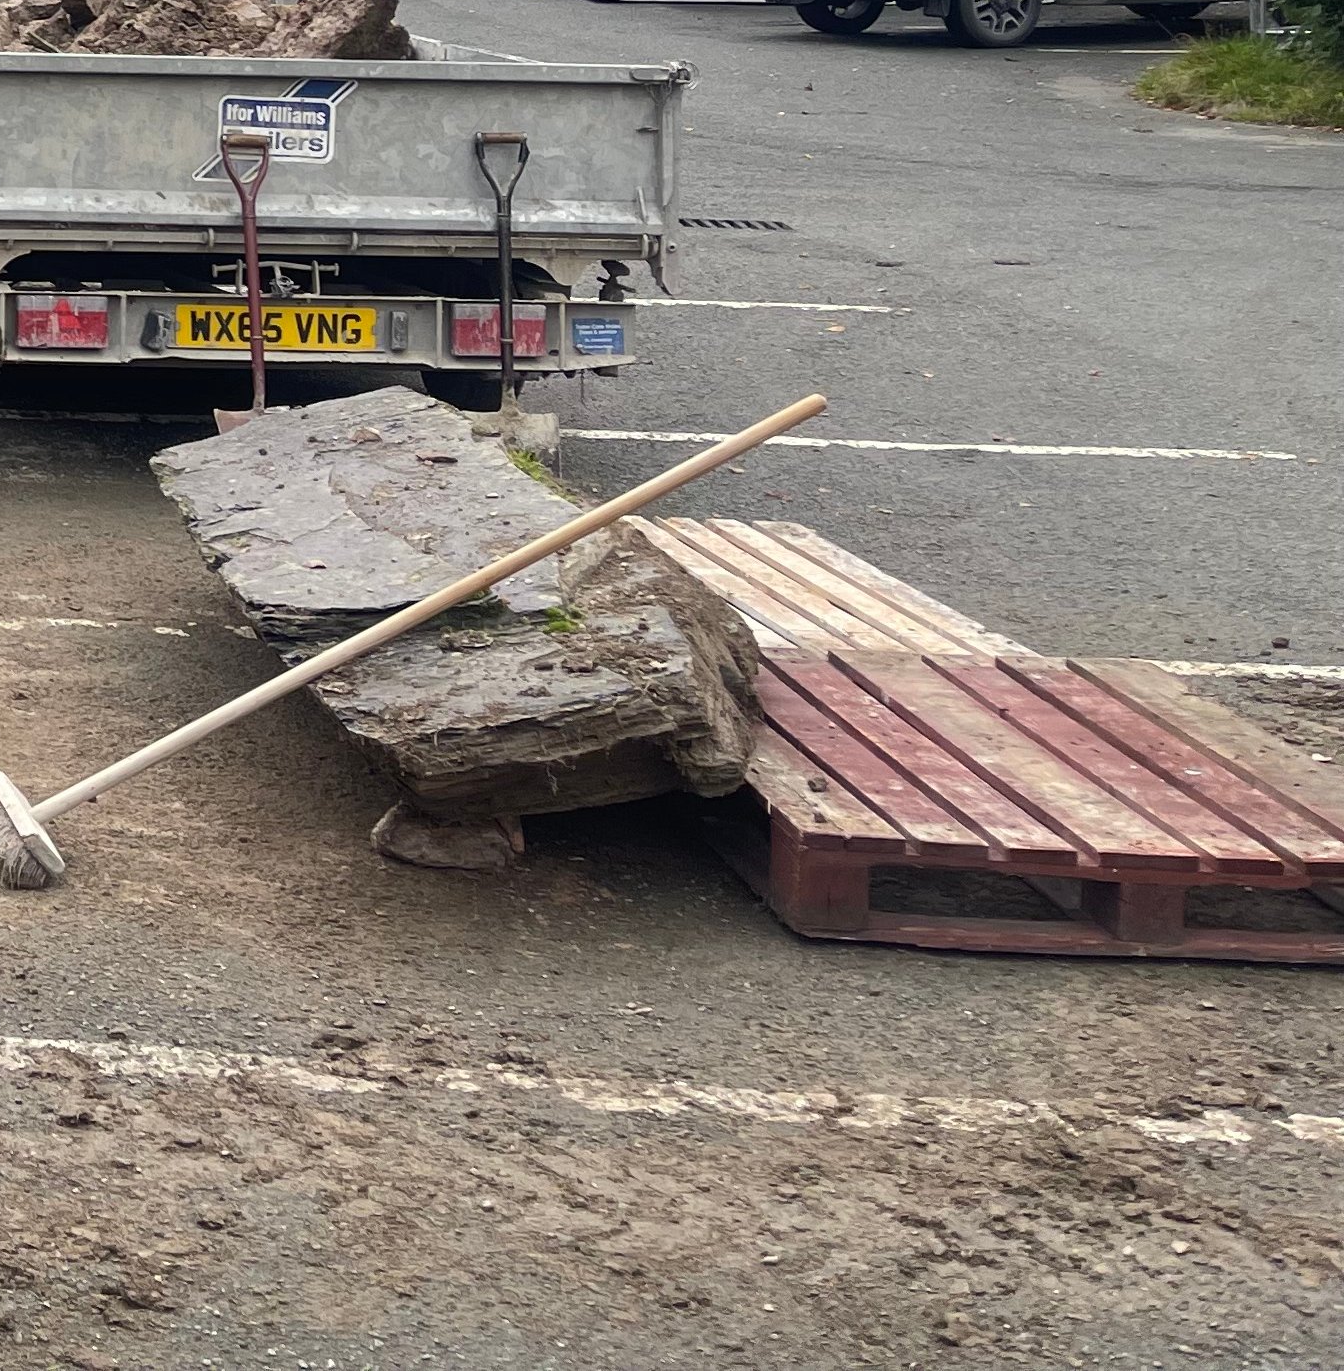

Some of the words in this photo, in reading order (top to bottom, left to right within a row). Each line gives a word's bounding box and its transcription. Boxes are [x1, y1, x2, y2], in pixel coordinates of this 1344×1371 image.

[226, 103, 254, 121] Ifor
[256, 104, 326, 126] Williams
[190, 310, 282, 343] WX65
[295, 312, 362, 345] VNG
